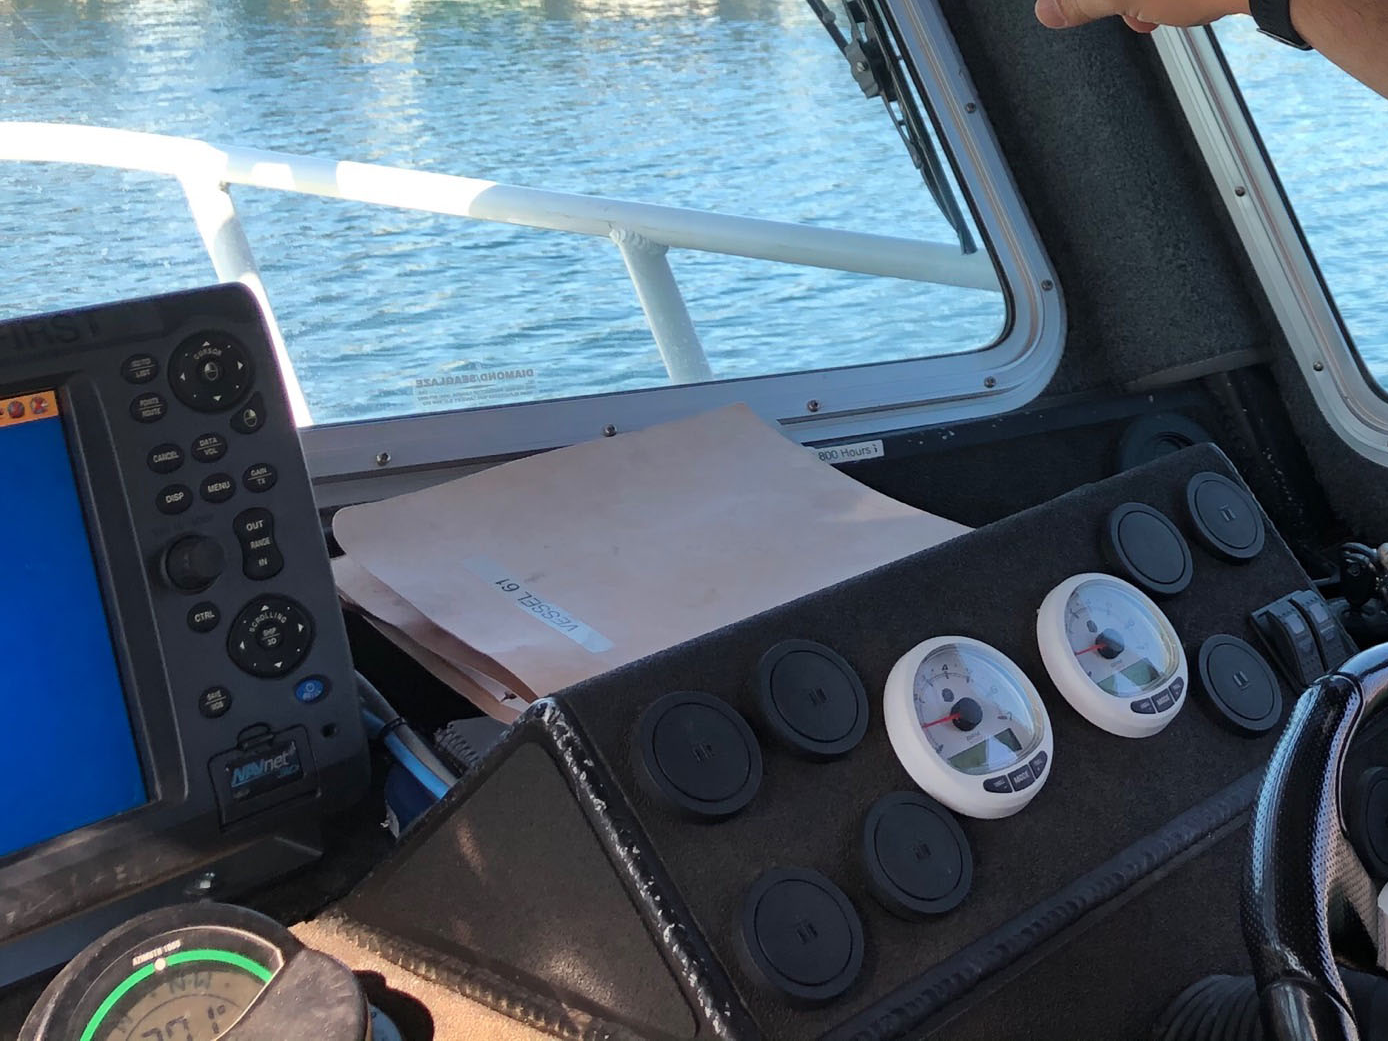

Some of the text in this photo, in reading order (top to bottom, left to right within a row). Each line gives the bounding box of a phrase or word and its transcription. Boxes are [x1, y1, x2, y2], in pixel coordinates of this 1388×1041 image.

[199, 437, 217, 447] DATA
[153, 451, 179, 463] CANCEL
[840, 446, 871, 458] Hours
[251, 467, 267, 476] GAIN
[207, 481, 230, 493] MENU
[165, 492, 185, 504] DISP
[246, 519, 264, 531] OUT
[250, 536, 271, 549] RANGE
[258, 557, 268, 567] IN
[495, 578, 578, 632] VESSEL 61
[194, 610, 215, 623] CTRL
[249, 612, 287, 633] SCROLLING
[267, 637, 277, 646] 3D
